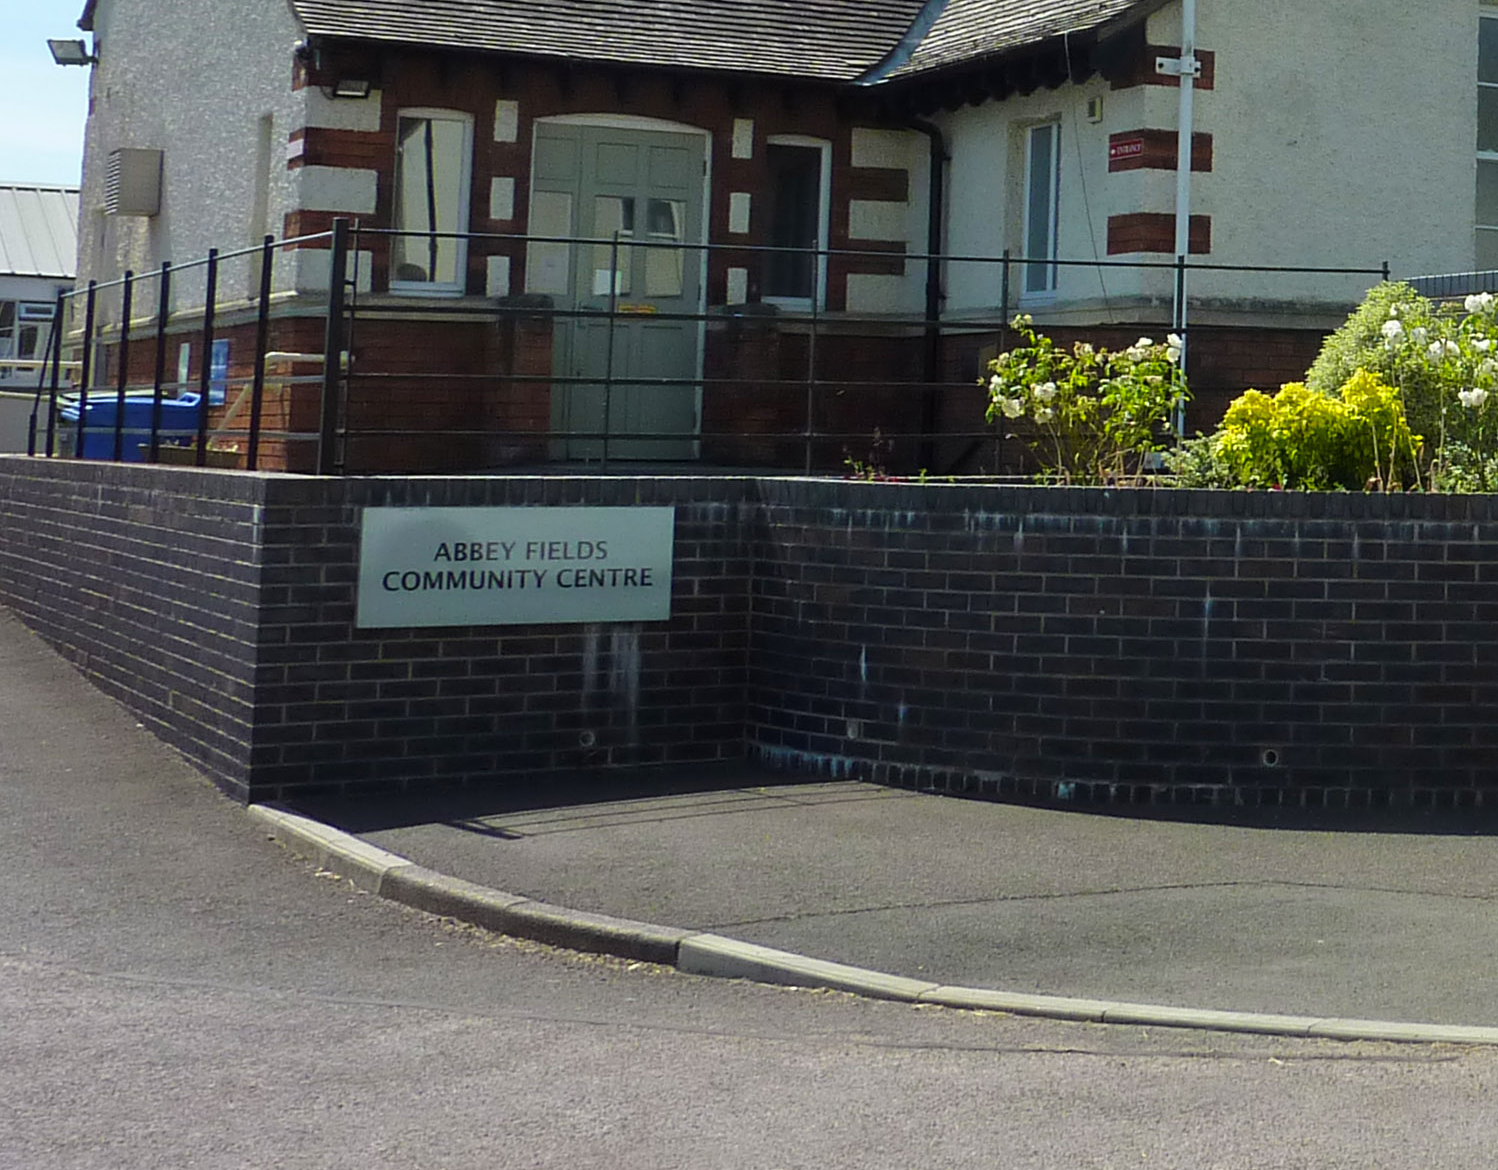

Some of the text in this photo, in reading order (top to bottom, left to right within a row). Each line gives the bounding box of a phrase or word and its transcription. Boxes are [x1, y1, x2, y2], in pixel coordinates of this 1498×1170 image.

[433, 541, 608, 562] ABBEY FIELDS
[382, 568, 653, 591] COMMUNITY CENTRE
